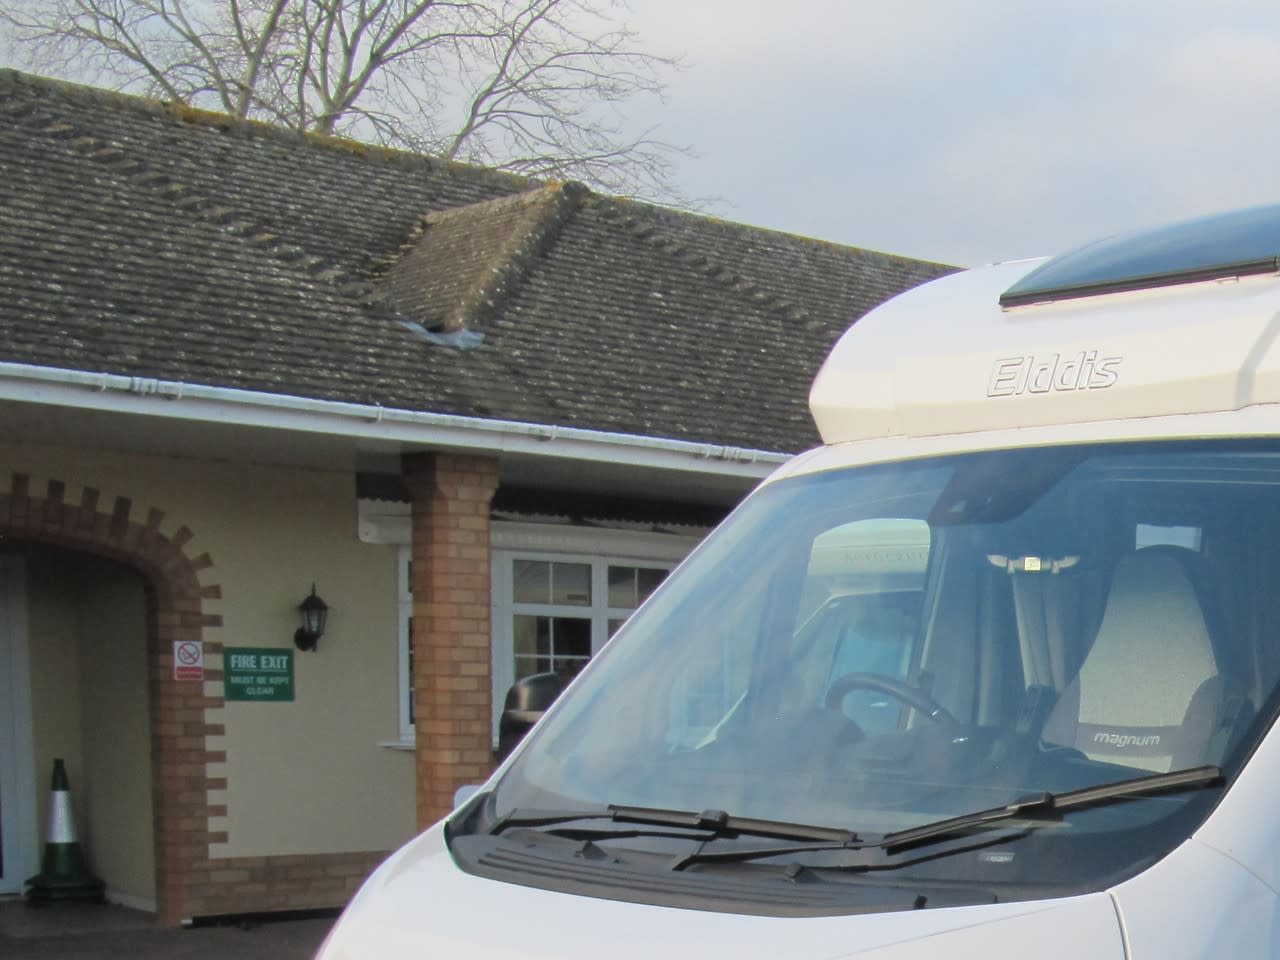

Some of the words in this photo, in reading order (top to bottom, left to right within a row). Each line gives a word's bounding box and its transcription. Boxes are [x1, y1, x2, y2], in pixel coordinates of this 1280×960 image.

[987, 350, 1123, 397] Elddis
[230, 654, 257, 669] FIRE
[261, 655, 289, 670] EXIT
[245, 687, 275, 696] CLEAR
[1093, 732, 1161, 748] magnum
